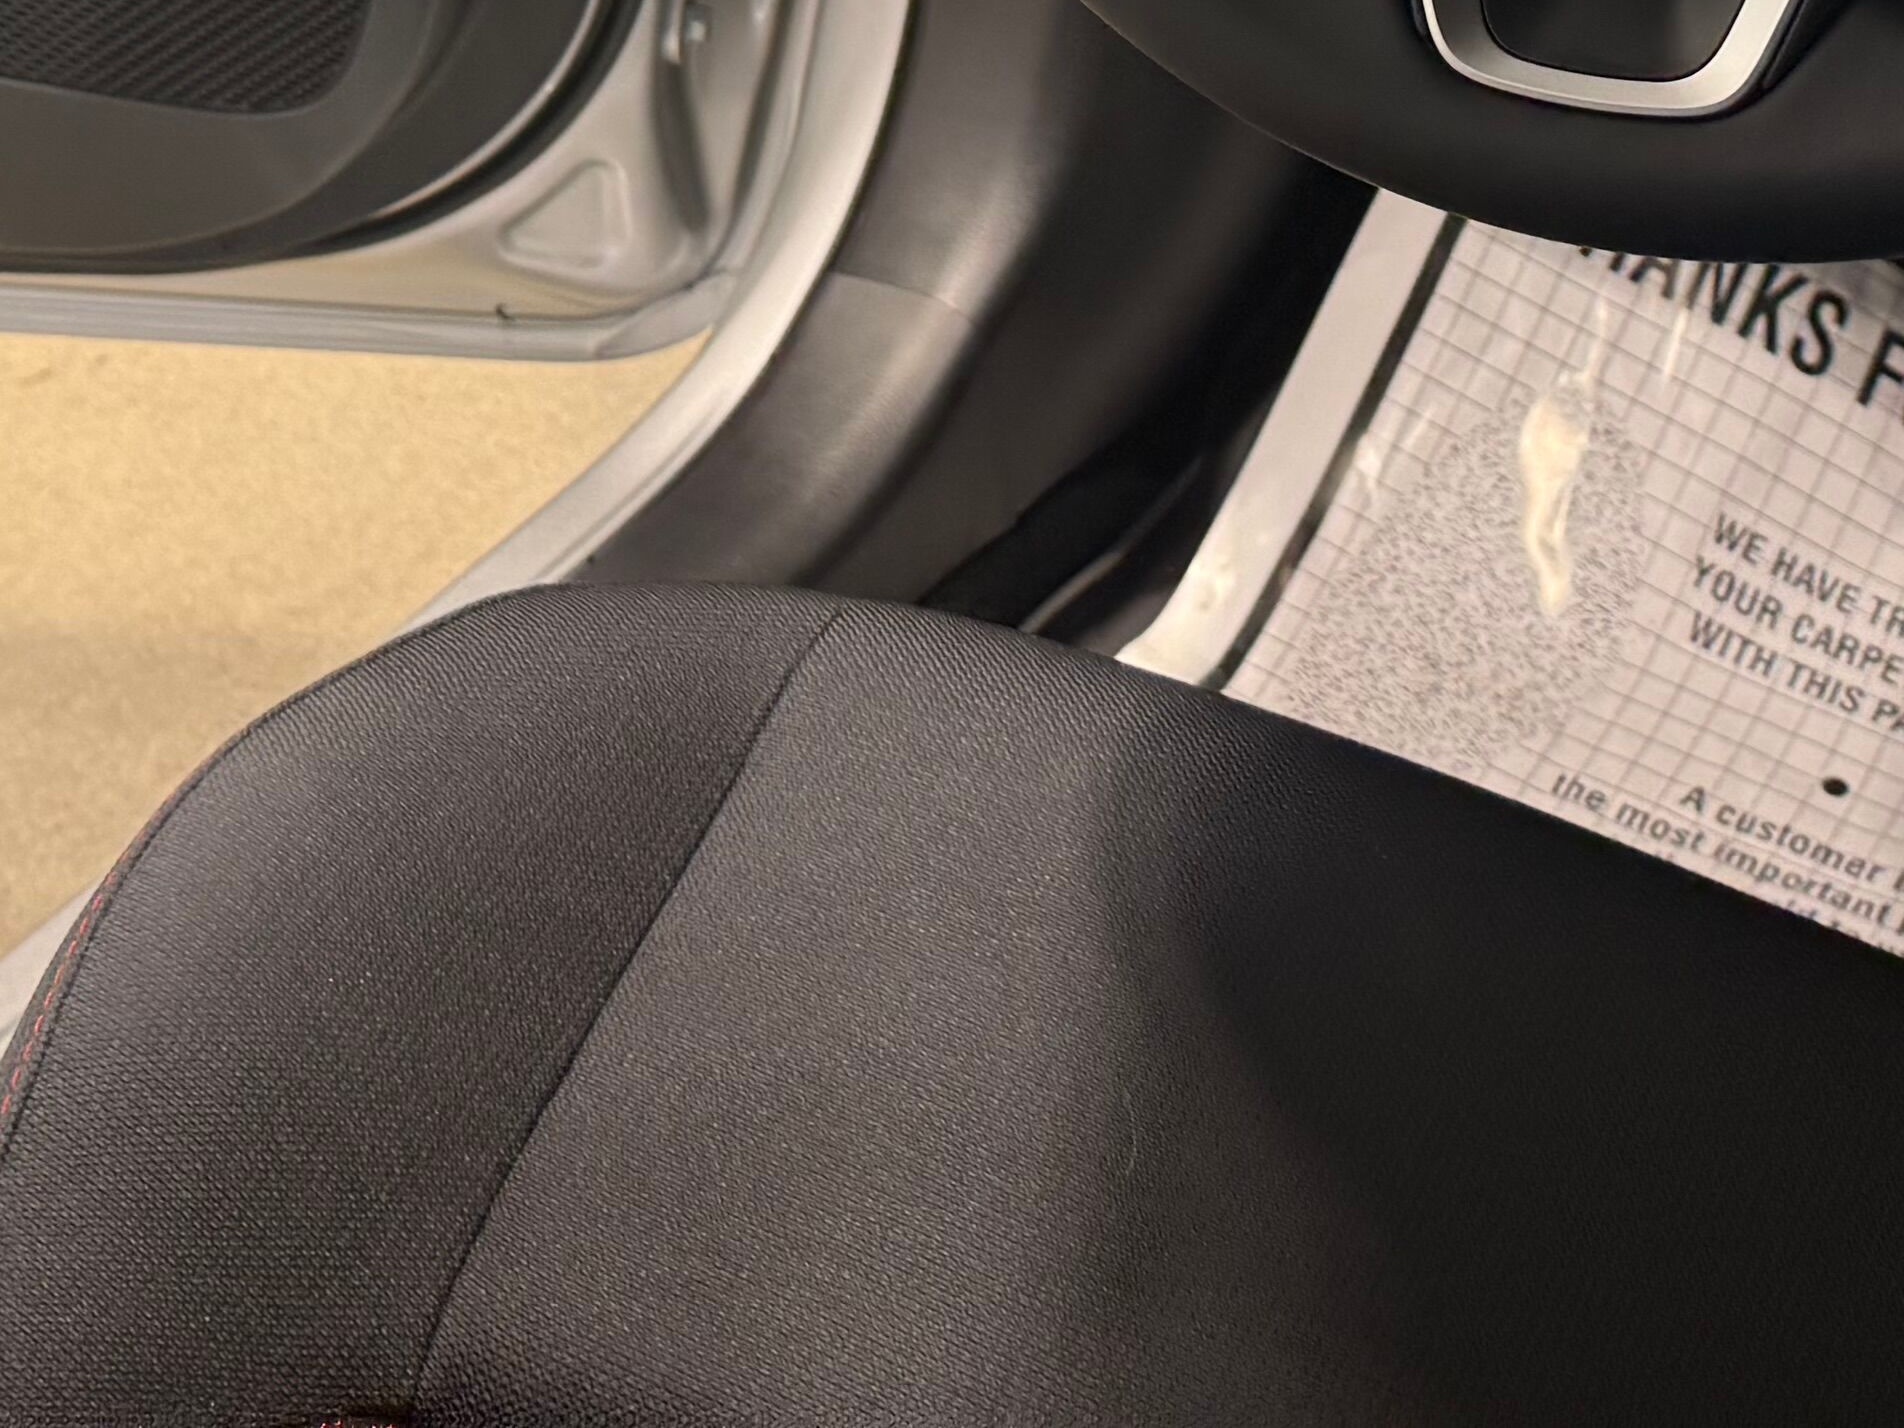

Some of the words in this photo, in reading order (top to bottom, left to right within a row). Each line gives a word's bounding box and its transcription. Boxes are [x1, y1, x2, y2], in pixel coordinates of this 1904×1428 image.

[1692, 555, 1784, 629] YOUR
[1713, 513, 1770, 565] WE
[1771, 546, 1862, 615] HAVE
[1689, 611, 1777, 677] WITH
[1784, 661, 1866, 715] THIS
[1551, 772, 1608, 812] the
[1615, 802, 1706, 853] most
[1712, 842, 1894, 927] important
[1679, 785, 1706, 813] A
[1715, 804, 1887, 884] customer
